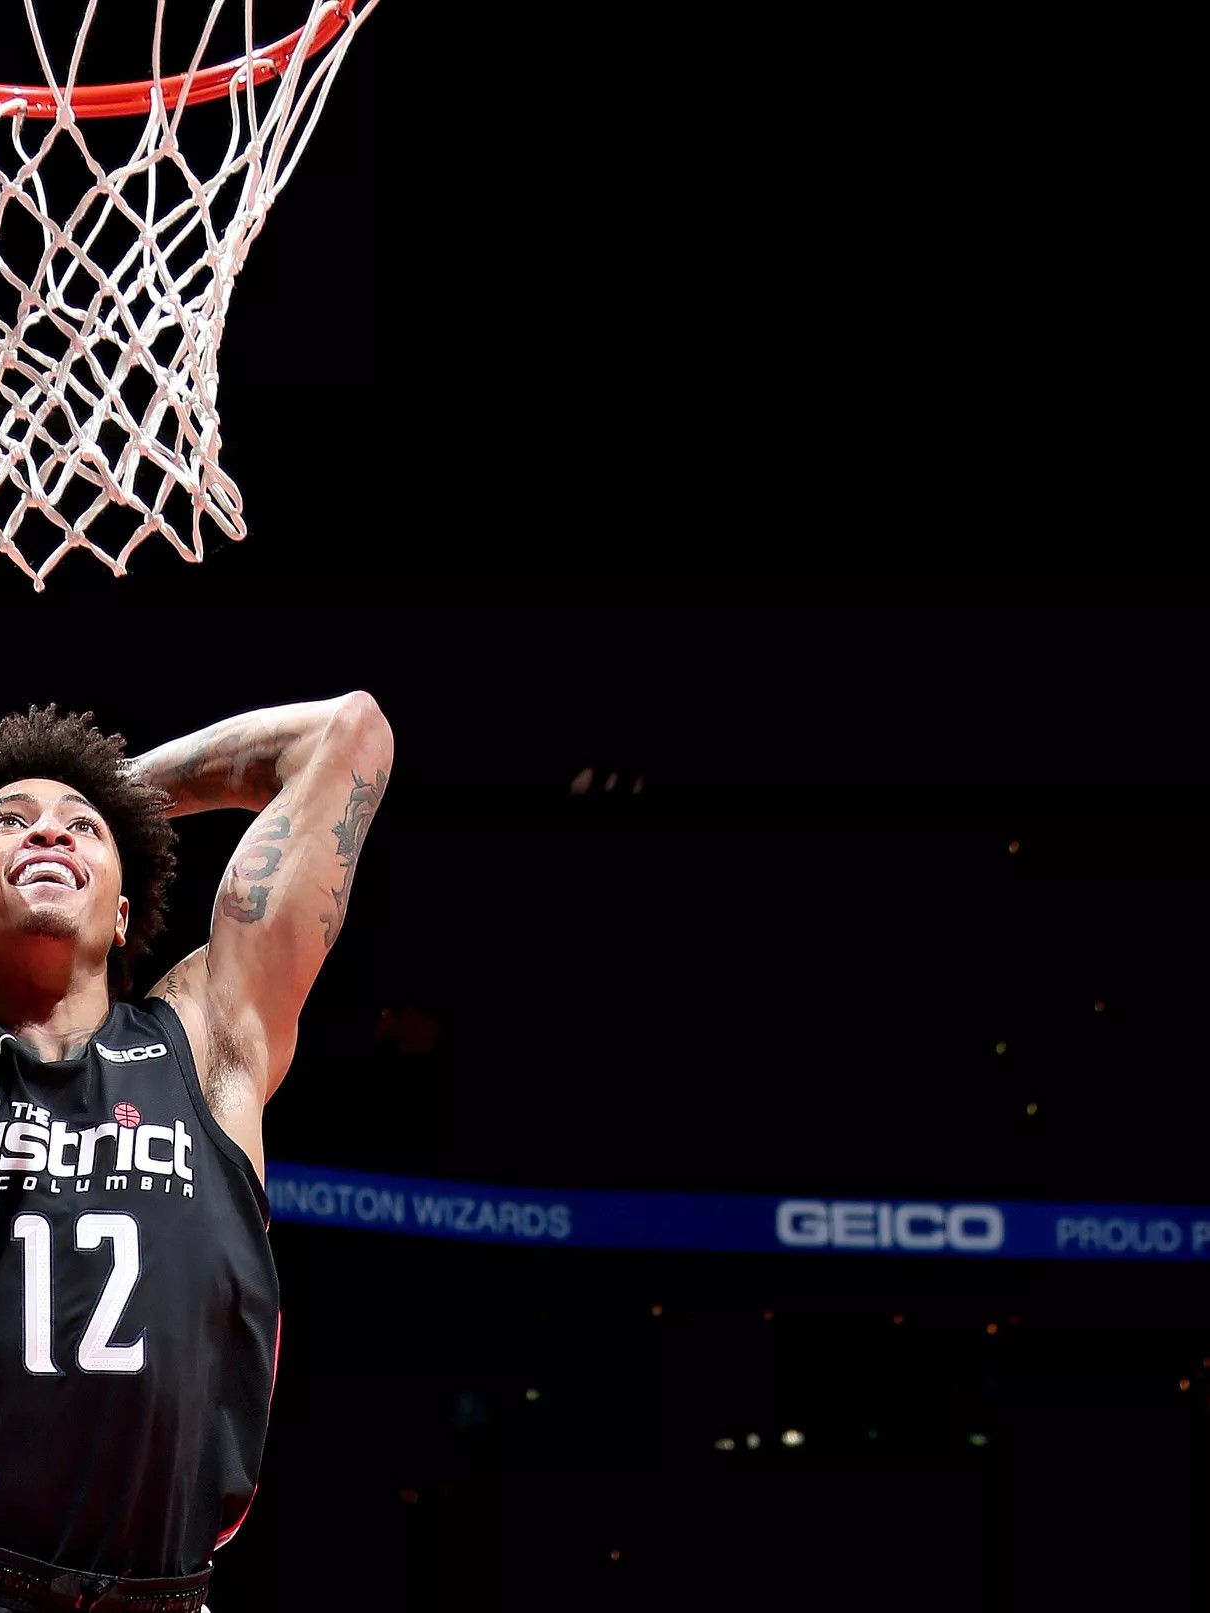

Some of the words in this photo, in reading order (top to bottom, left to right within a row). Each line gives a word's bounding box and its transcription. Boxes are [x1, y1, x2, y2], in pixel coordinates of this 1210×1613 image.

[11, 1101, 52, 1125] THE
[267, 1179, 406, 1224] INGTON
[412, 1195, 572, 1239] WIZARDS
[775, 1200, 1005, 1251] GEICO
[1055, 1216, 1185, 1254] PROUD
[12, 1211, 147, 1376] 12
